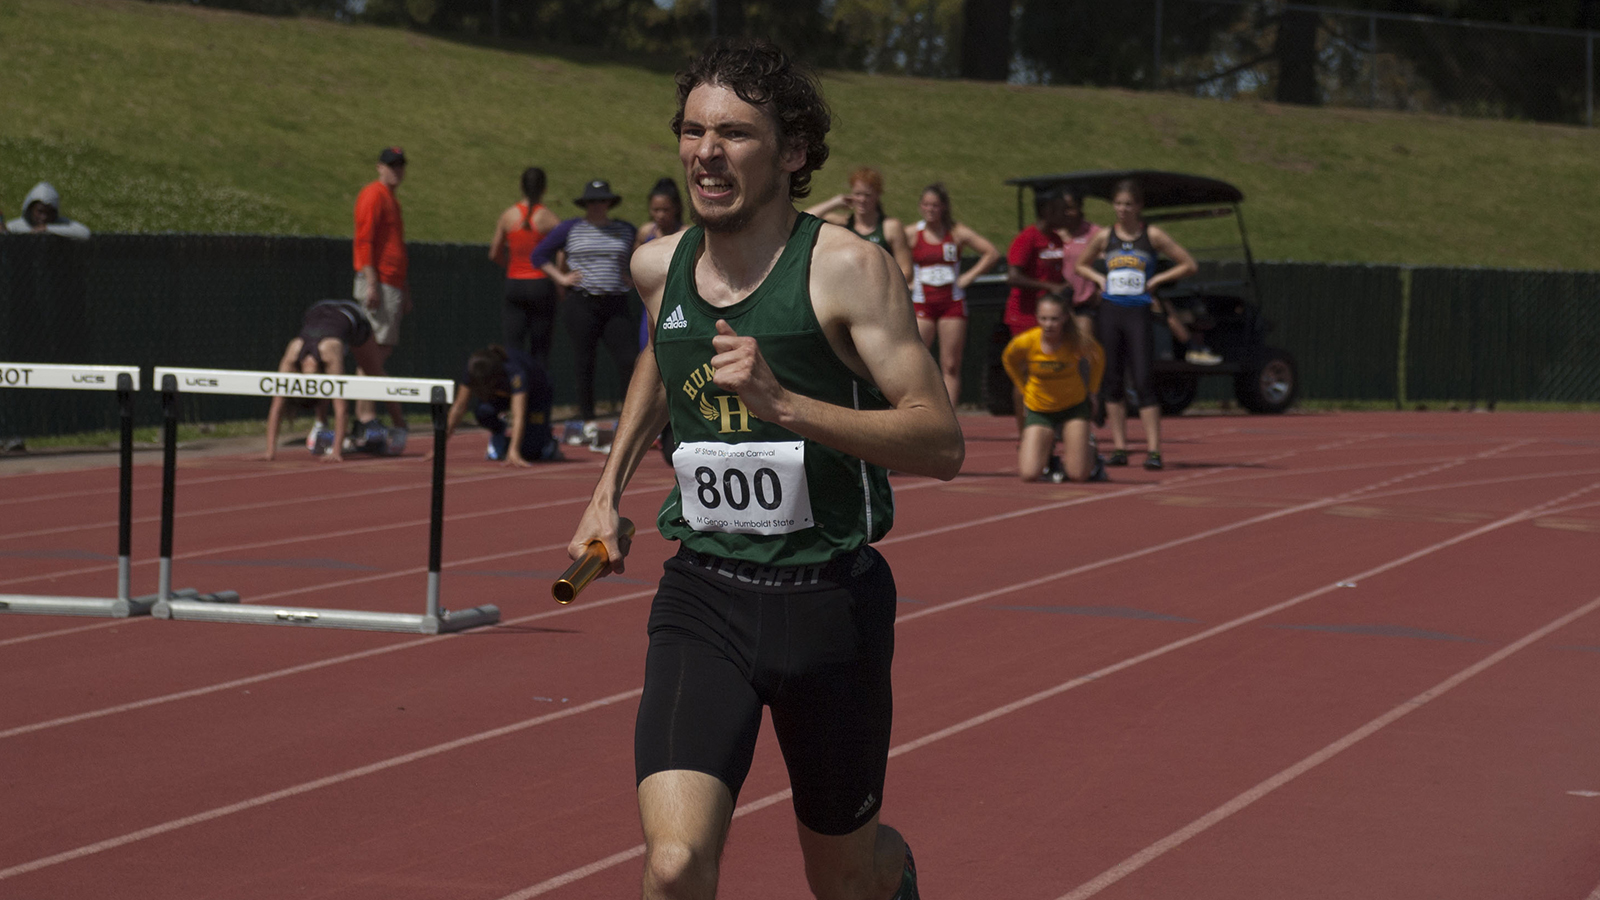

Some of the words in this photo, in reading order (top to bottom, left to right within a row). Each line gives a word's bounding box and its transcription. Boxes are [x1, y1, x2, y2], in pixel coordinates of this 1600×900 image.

[663, 319, 688, 330] adidas
[72, 374, 105, 384] UCS
[186, 377, 219, 387] UCS
[260, 377, 349, 397] CHABOT
[386, 387, 420, 396] UCS
[714, 395, 752, 433] H
[695, 447, 702, 455] SF
[702, 448, 717, 457] State
[746, 449, 776, 458] Carnival
[694, 466, 783, 511] 800
[696, 516, 703, 524] M
[734, 519, 771, 528] Humboldt
[772, 519, 795, 527] State
[703, 555, 829, 588] TECHFIT
